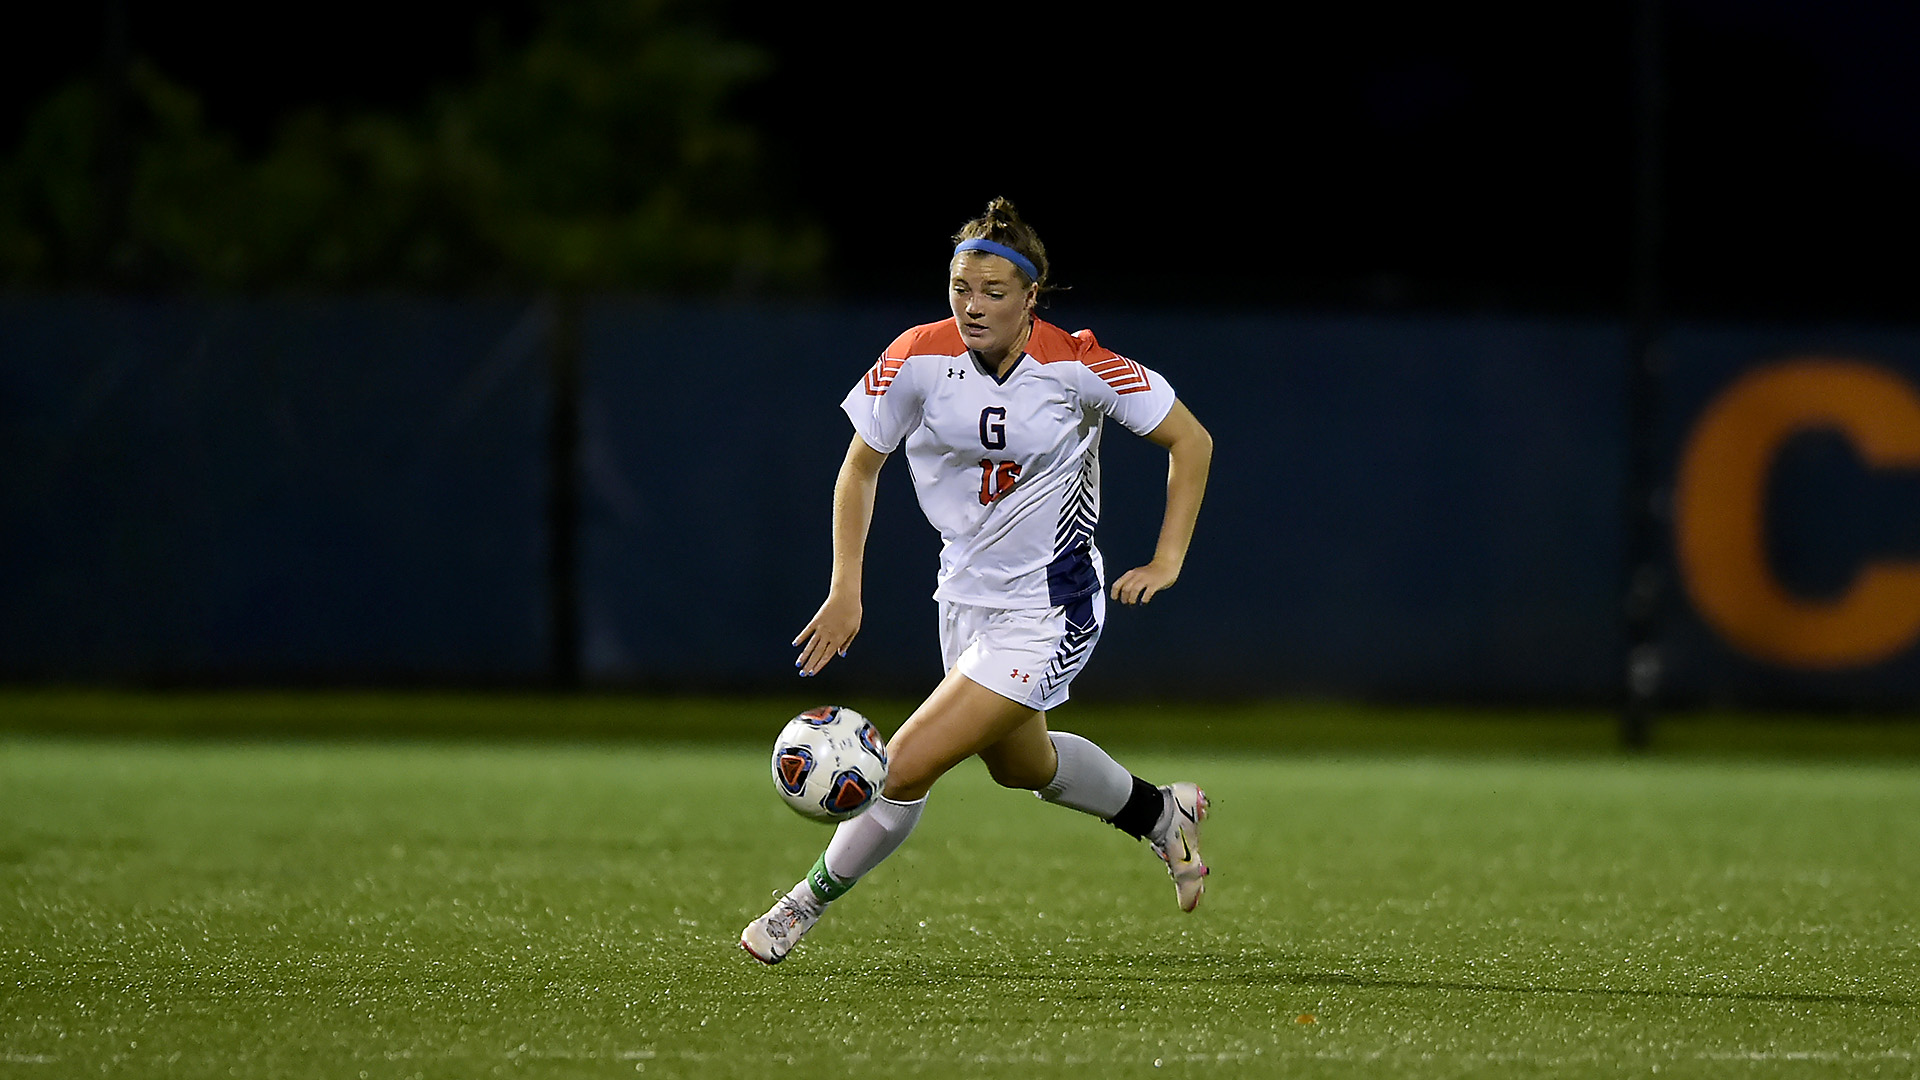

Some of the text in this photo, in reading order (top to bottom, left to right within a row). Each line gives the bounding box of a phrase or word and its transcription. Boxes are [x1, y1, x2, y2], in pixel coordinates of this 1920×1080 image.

[979, 406, 1007, 451] G
[977, 458, 1023, 506] 16
[1675, 358, 1920, 667] C
